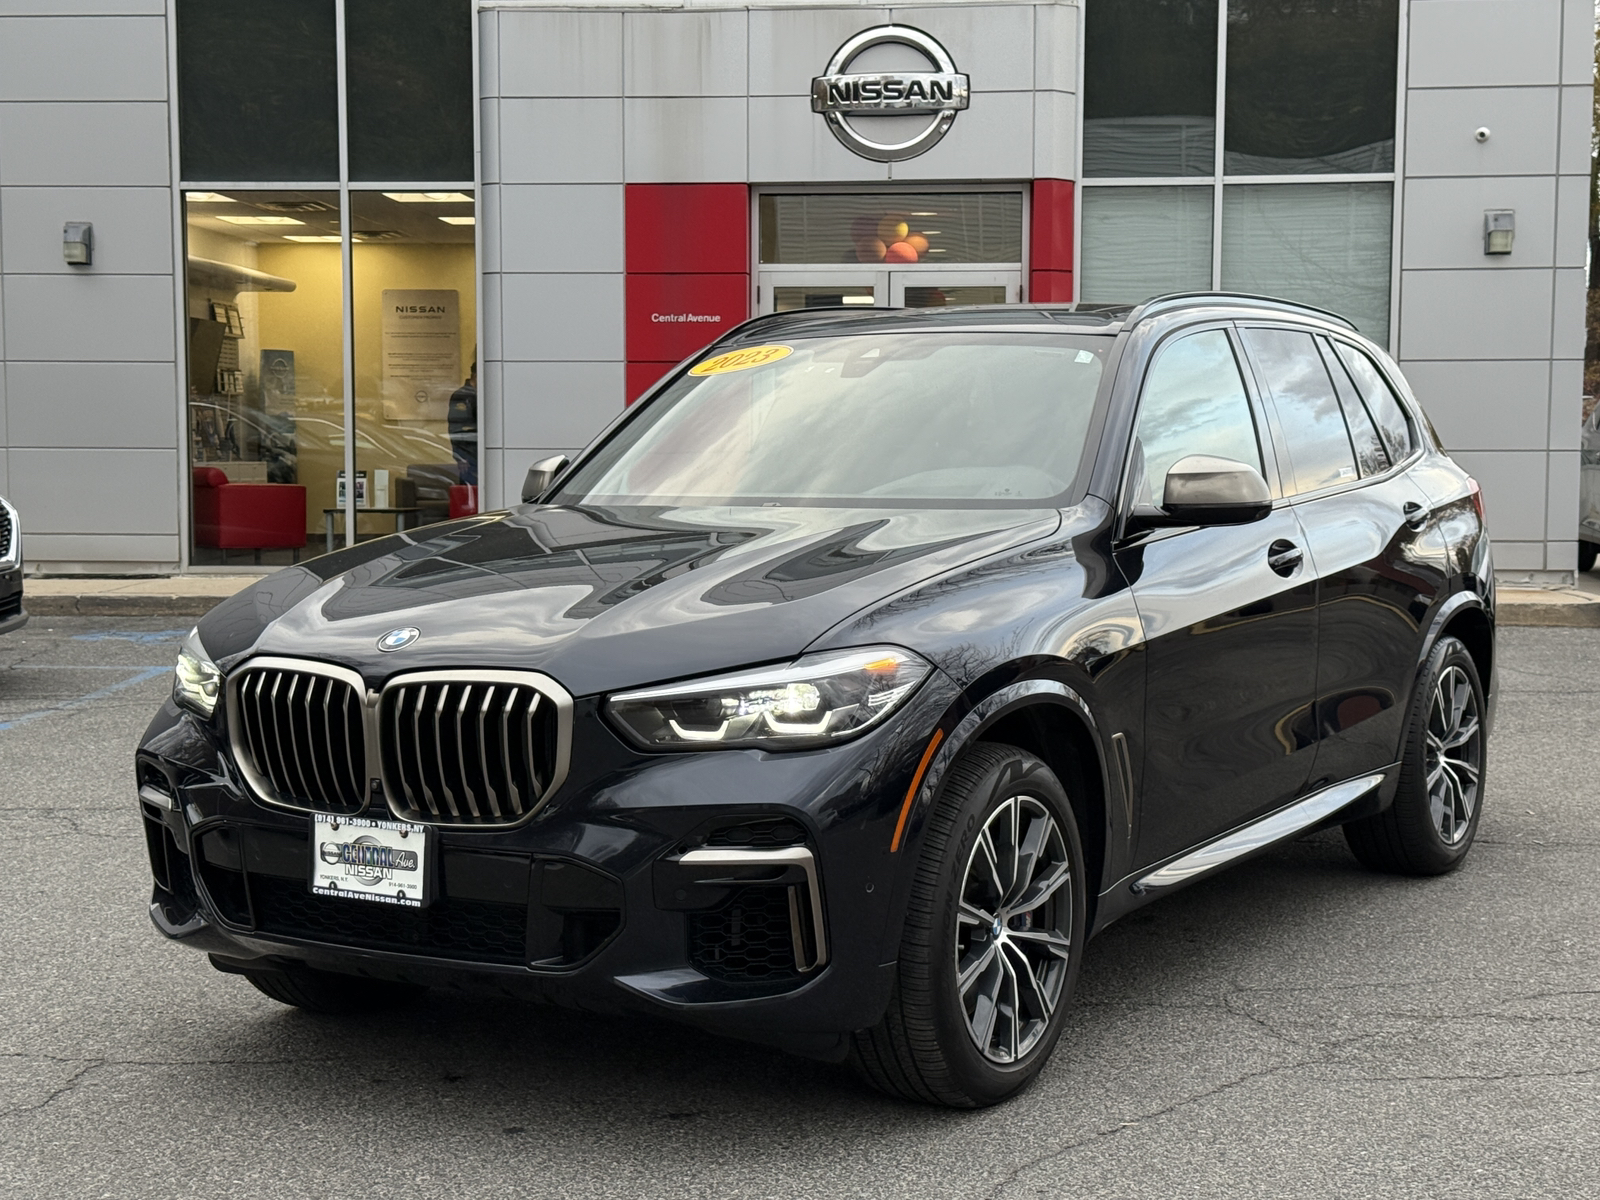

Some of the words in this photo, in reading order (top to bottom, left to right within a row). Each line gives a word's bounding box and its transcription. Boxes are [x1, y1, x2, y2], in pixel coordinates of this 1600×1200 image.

[827, 80, 953, 105] NISSAN
[395, 305, 446, 313] NISSAN
[651, 313, 687, 322] Central
[687, 313, 721, 323] Avenue
[701, 348, 780, 373] 2023
[344, 863, 393, 880] NISSAN
[313, 887, 421, 907] CentralAveNissan.com
